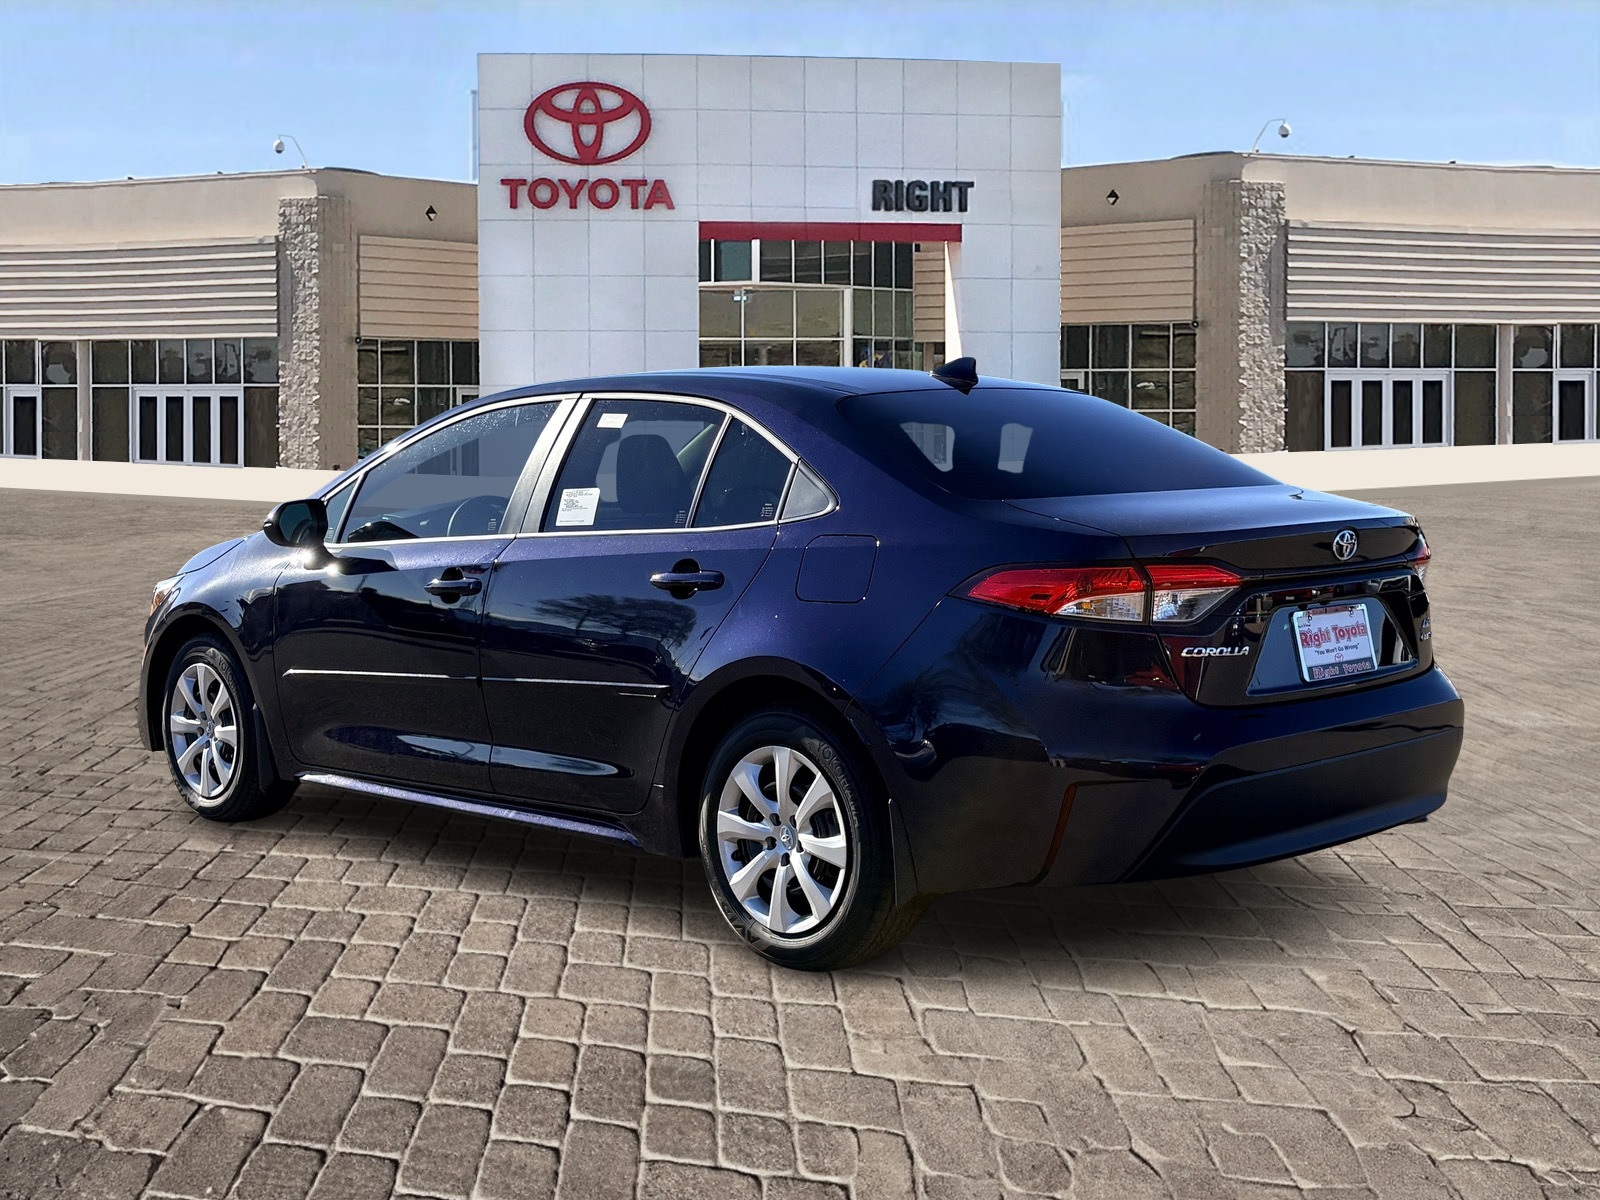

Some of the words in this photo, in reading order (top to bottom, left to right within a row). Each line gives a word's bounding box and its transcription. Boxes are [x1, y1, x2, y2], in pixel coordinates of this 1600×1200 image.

[500, 178, 676, 210] TOYOTA
[871, 179, 975, 213] RIGHT
[1300, 627, 1332, 649] Right
[1332, 622, 1367, 643] Toyota
[1181, 645, 1250, 658] COROLLA
[1325, 647, 1338, 655] Won't
[1313, 666, 1339, 679] Right
[1343, 661, 1371, 674] Toyota
